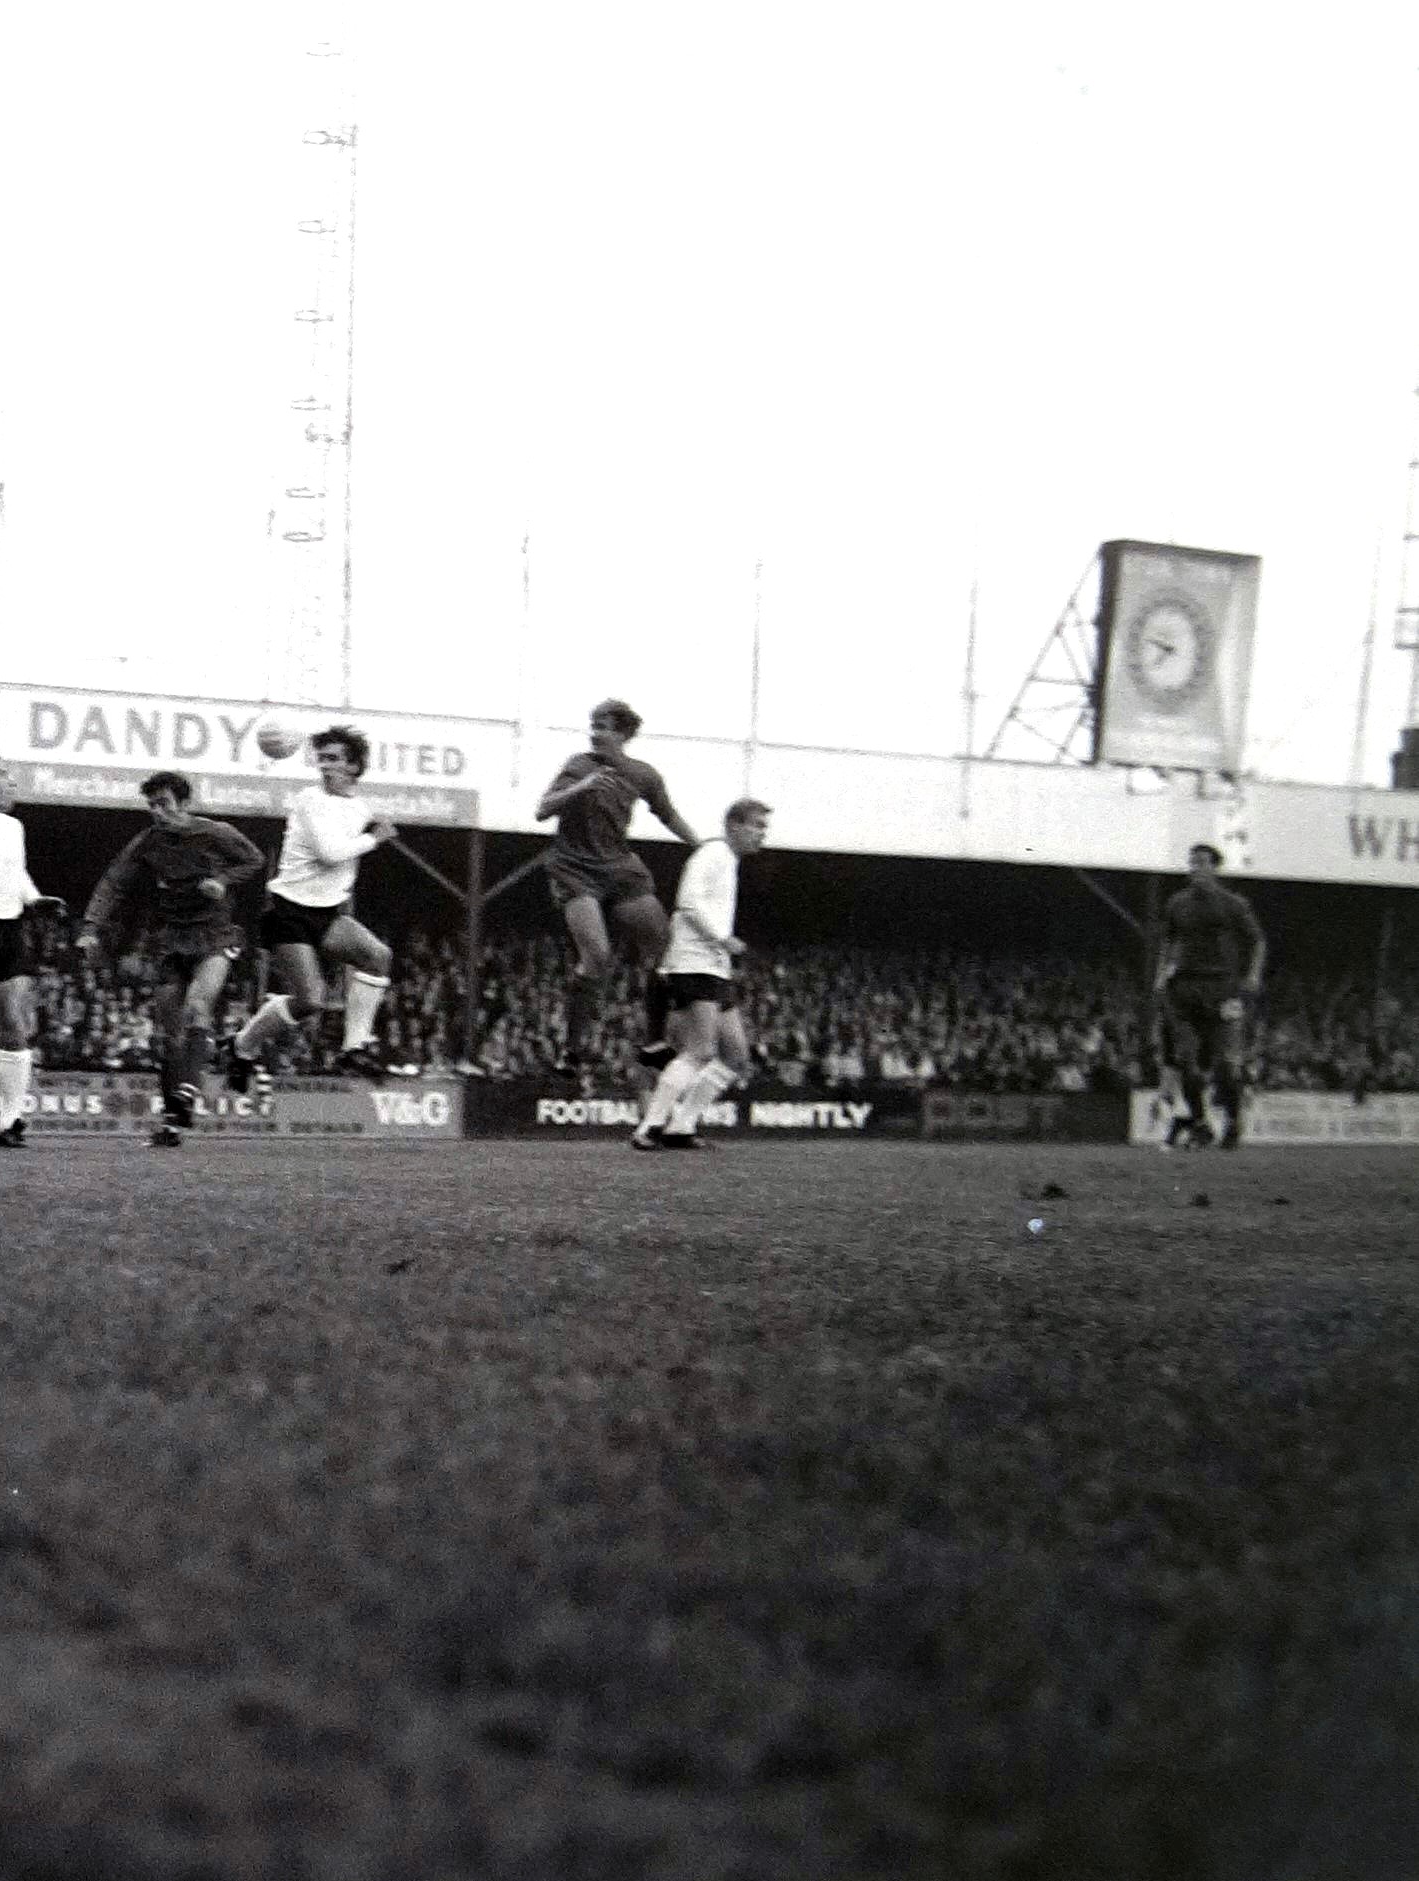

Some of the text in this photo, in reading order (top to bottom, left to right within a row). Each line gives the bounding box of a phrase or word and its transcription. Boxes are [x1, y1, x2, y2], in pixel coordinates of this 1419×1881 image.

[29, 700, 262, 763] DANDY
[149, 1095, 274, 1117] PLICY
[367, 1090, 450, 1127] V&G
[535, 1099, 644, 1126] FOOTBAL
[749, 1101, 873, 1129] NIGHTLY
